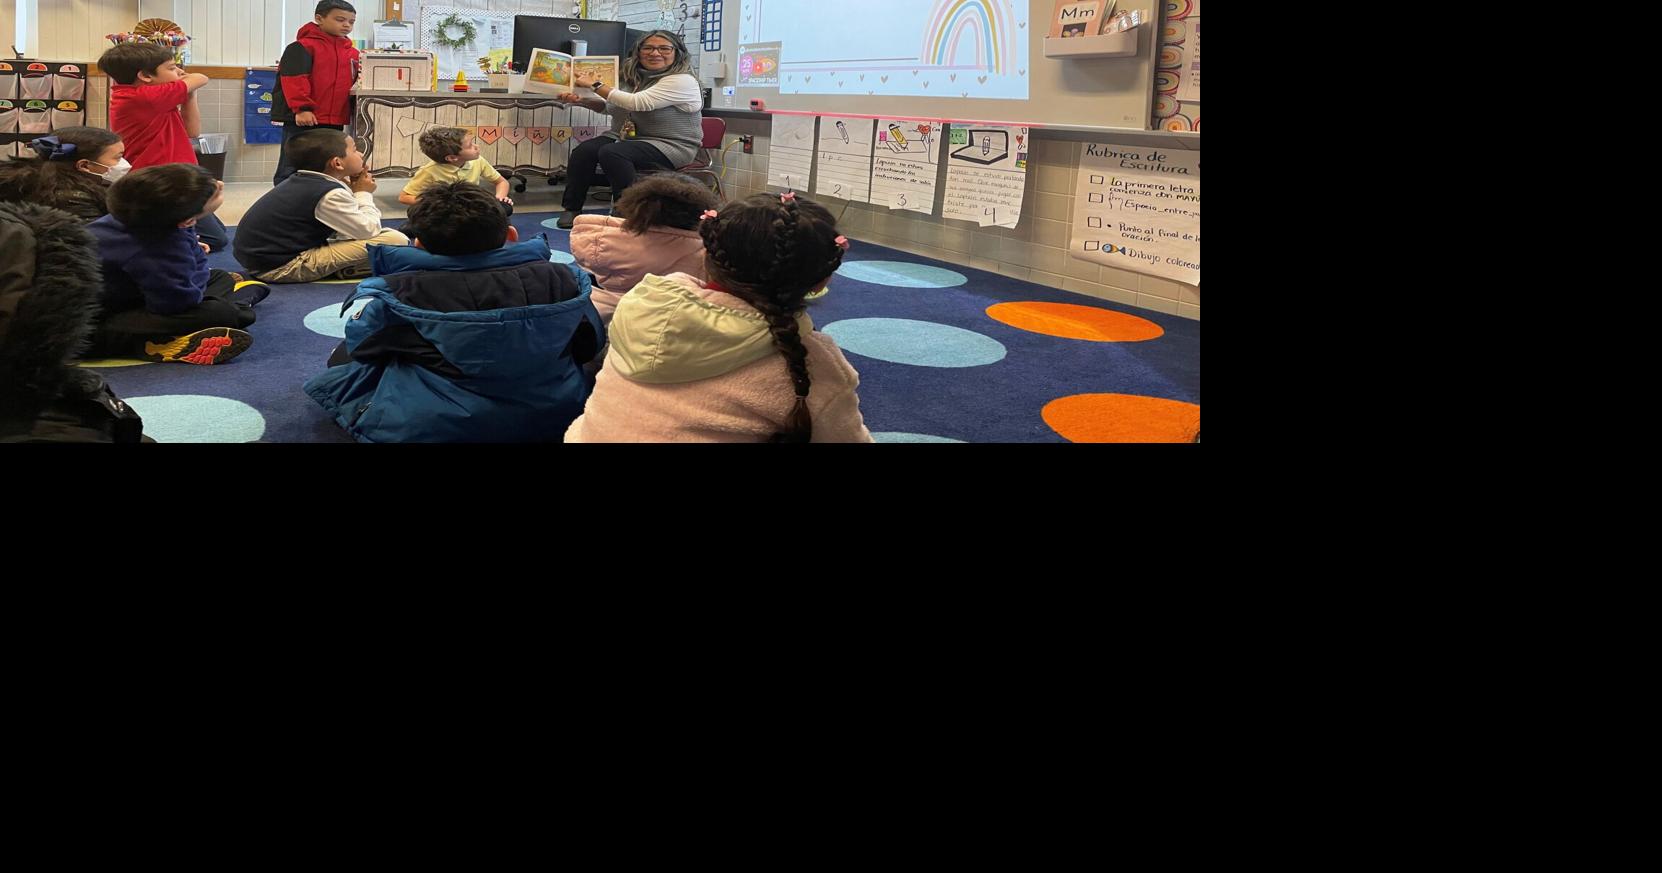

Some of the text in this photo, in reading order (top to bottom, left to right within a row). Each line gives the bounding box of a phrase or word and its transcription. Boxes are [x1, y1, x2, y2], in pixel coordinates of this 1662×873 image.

[679, 3, 688, 21] 3
[1061, 7, 1095, 19] Mm
[1146, 151, 1167, 162] de
[1119, 159, 1190, 175] Escritura
[833, 184, 842, 195] 2
[1110, 177, 1194, 194] La primera letra
[897, 193, 907, 206] 3
[984, 207, 996, 224] 4
[1119, 222, 1142, 233] Punto
[1144, 227, 1154, 235] al
[1182, 233, 1193, 241] de
[1128, 248, 1161, 265] Dibujo
